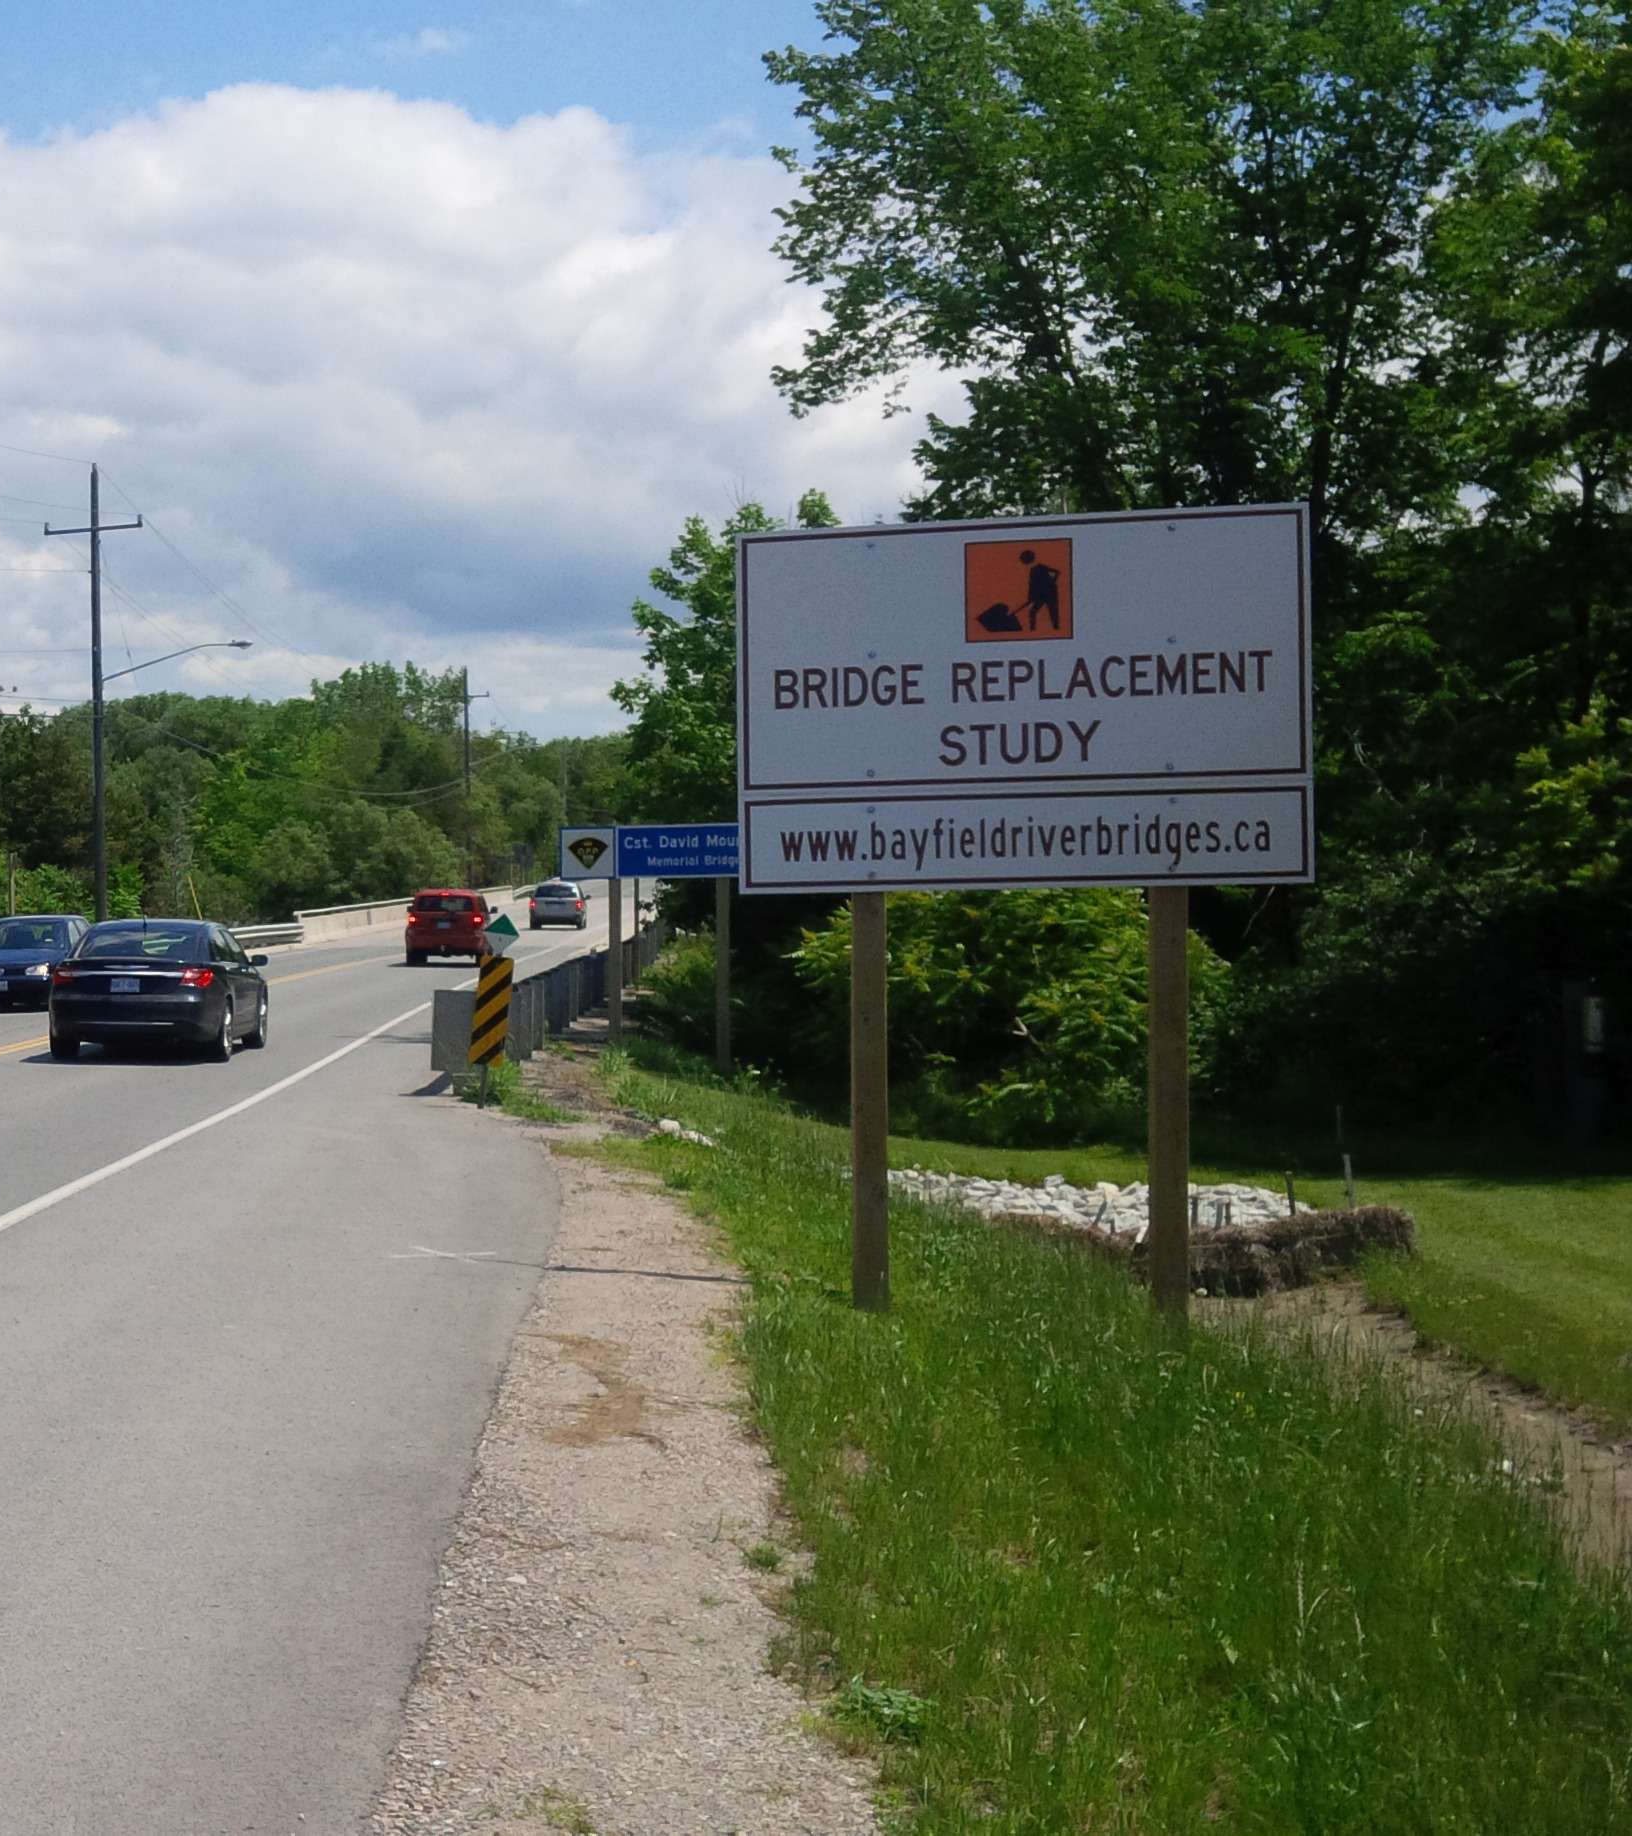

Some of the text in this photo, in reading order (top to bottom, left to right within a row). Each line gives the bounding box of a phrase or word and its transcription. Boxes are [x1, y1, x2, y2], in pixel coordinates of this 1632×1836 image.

[774, 650, 1273, 710] BRIDGE REPLACEMENT
[938, 719, 1102, 767] STUDY
[624, 836, 653, 849] Cst.
[659, 834, 699, 848] David
[647, 855, 699, 867] Memorial
[780, 814, 1272, 867] www.bayfieldriverbridges.ca
